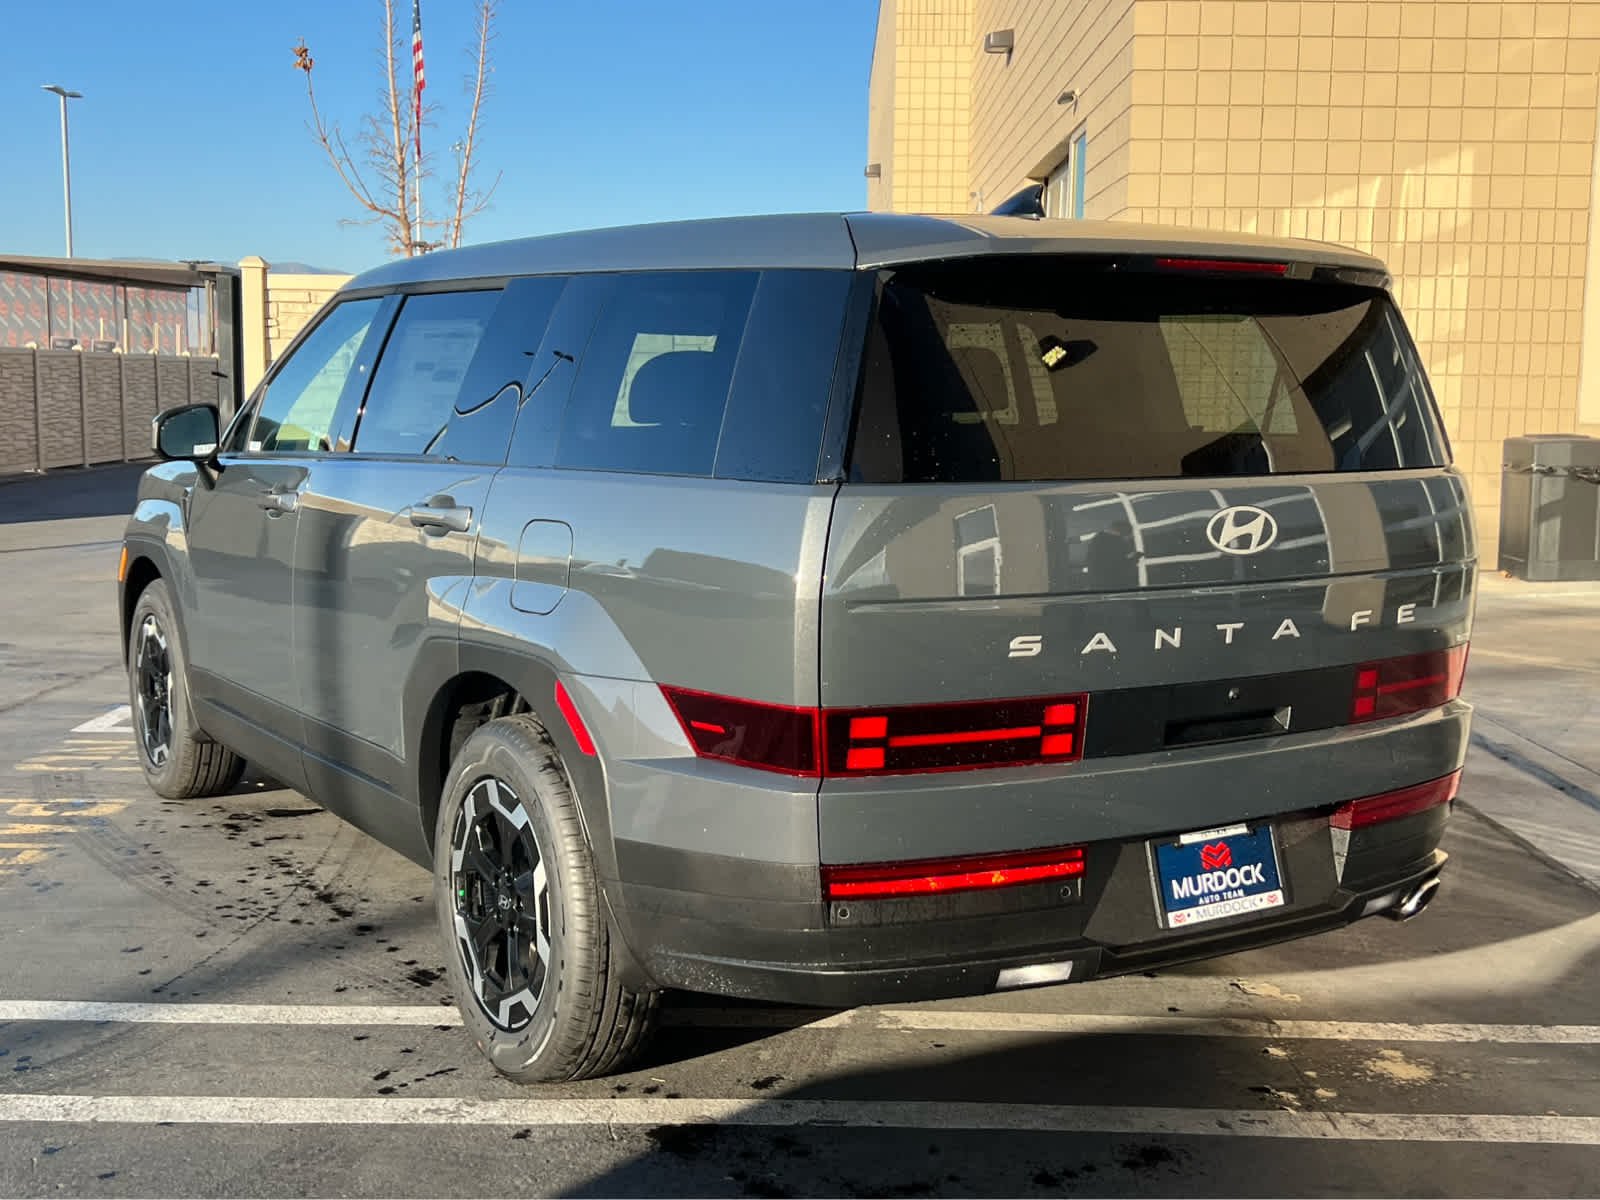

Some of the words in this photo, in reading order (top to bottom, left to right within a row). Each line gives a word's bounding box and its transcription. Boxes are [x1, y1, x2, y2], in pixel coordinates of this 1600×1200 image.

[1008, 618, 1301, 658] SANTA
[1350, 603, 1417, 632] FE
[1172, 863, 1265, 899] MURDOCK
[1196, 897, 1258, 919] MURDOCK
[1199, 893, 1220, 905] AUTO
[1223, 888, 1244, 900] TEAM
